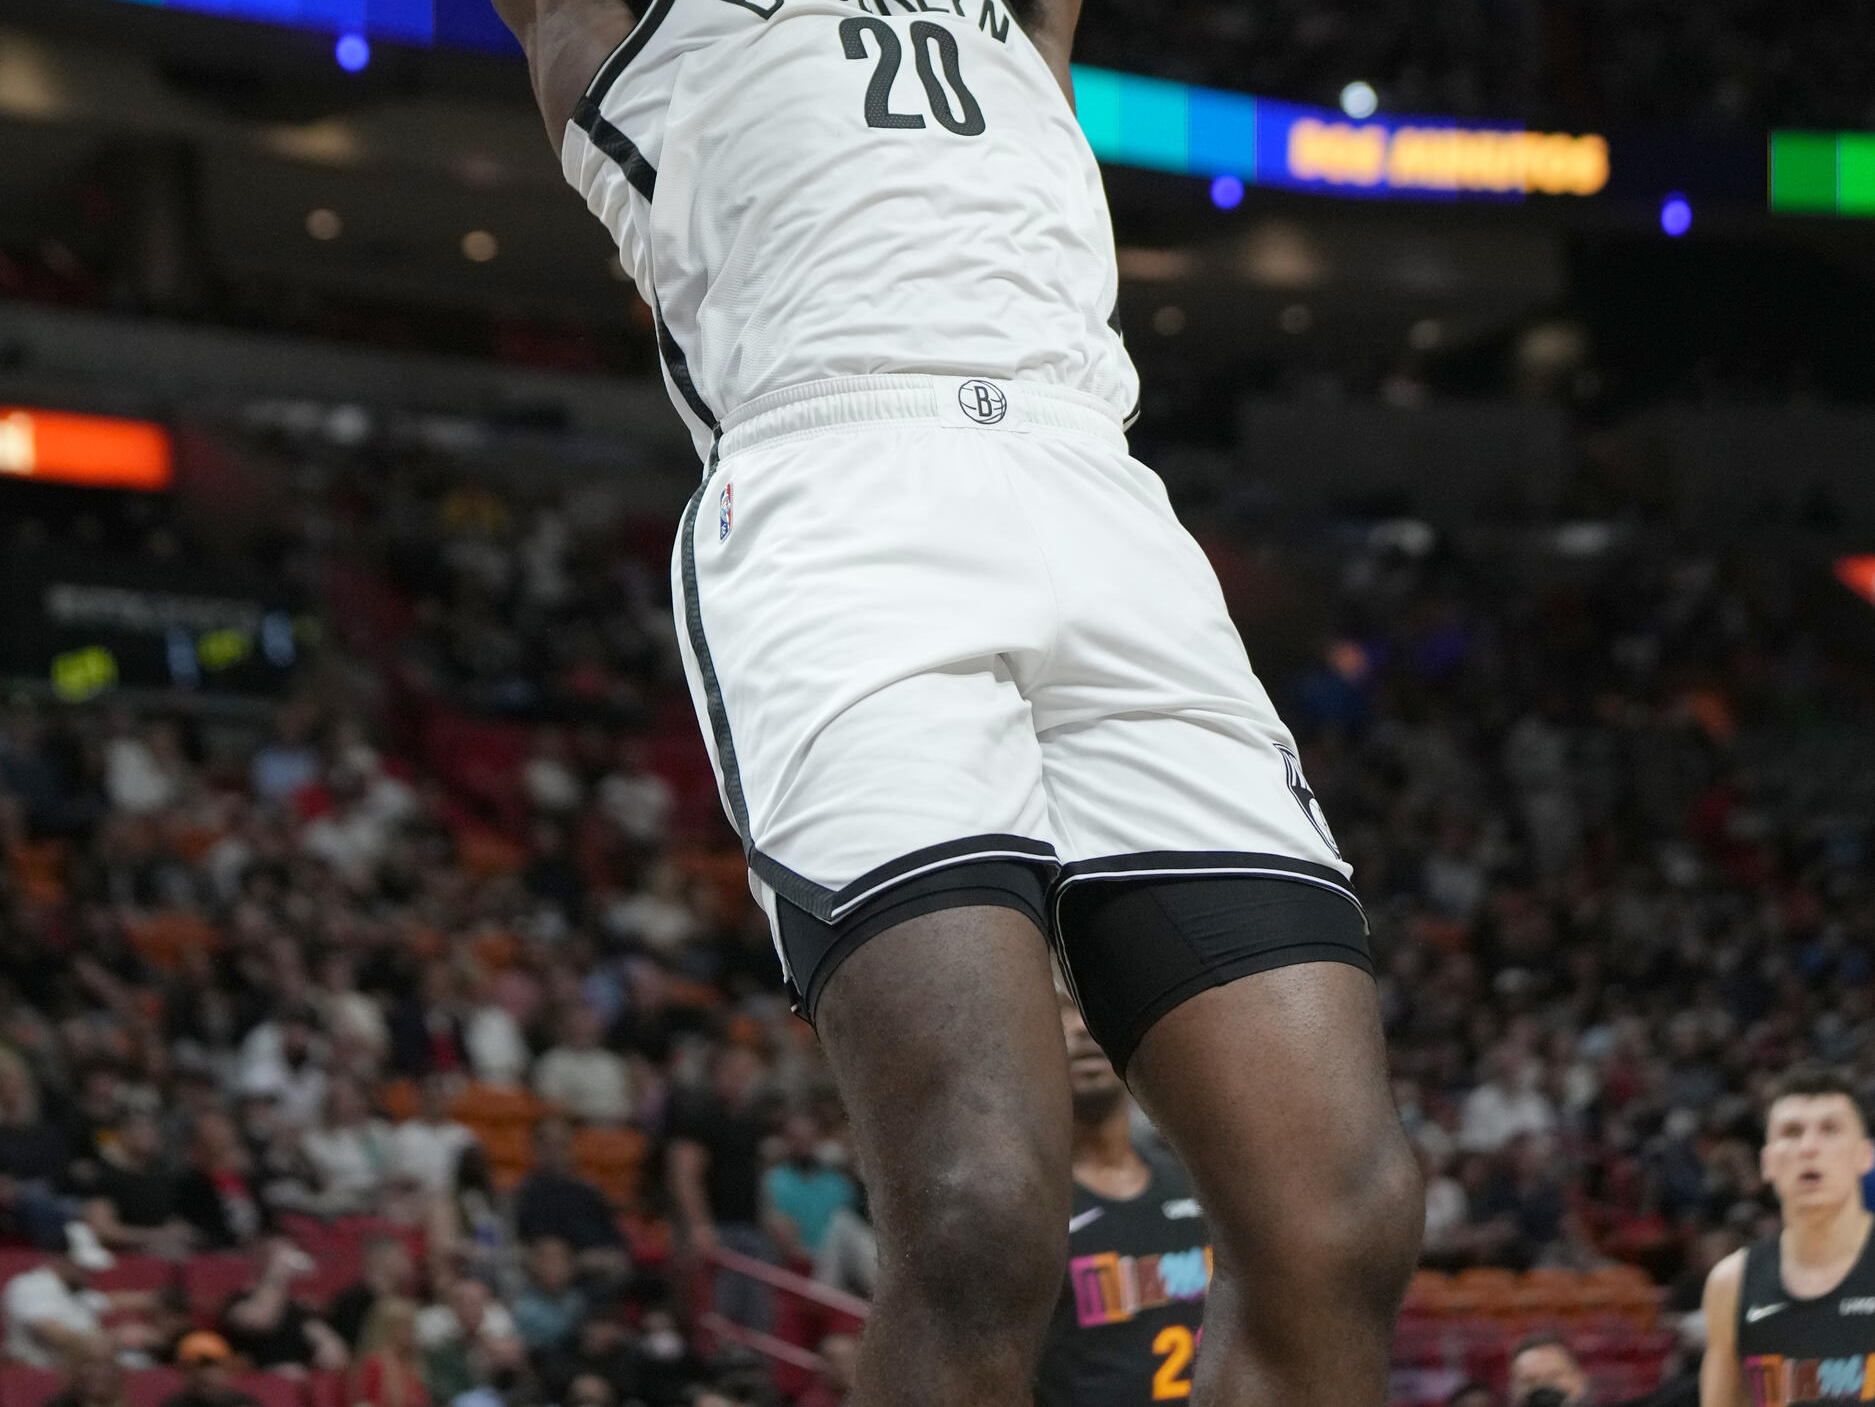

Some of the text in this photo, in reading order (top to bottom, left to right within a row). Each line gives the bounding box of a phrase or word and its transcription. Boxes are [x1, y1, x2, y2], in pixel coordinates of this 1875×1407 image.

[838, 16, 986, 137] 20
[973, 385, 993, 417] B
[1152, 1324, 1204, 1401] 2
